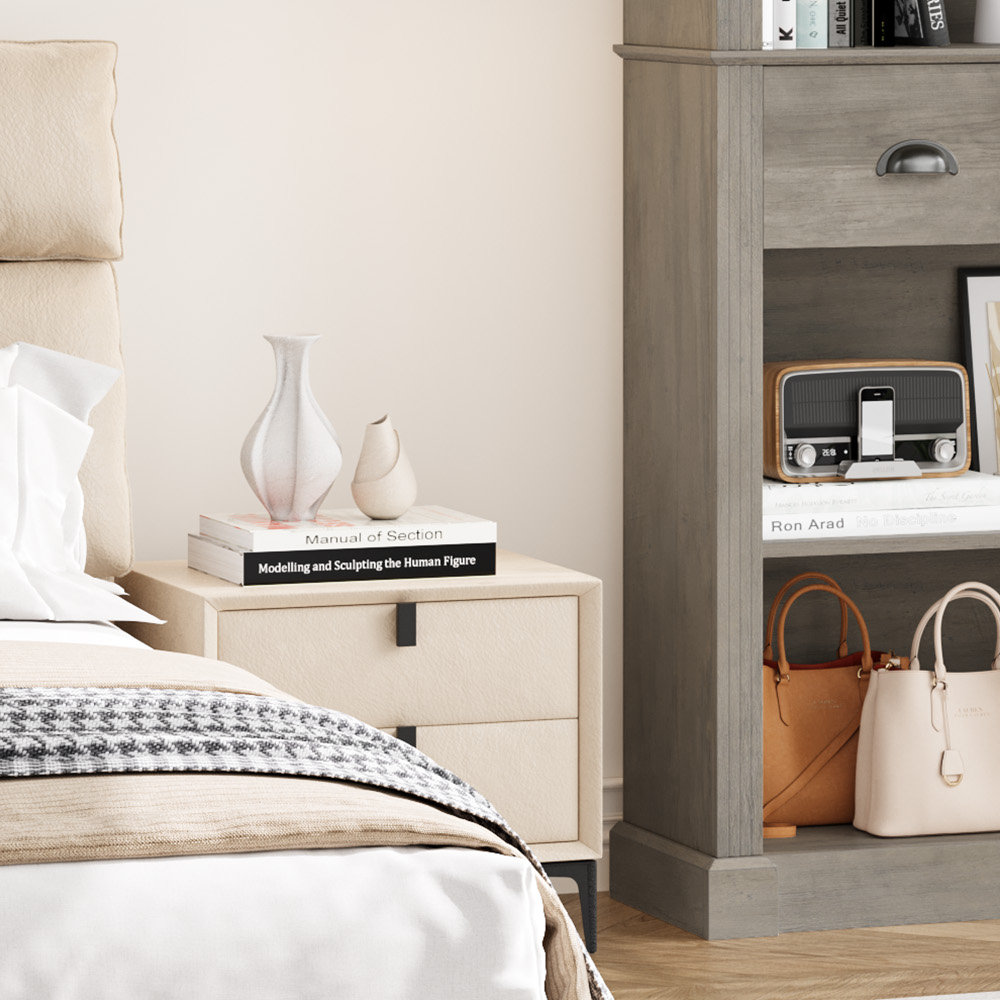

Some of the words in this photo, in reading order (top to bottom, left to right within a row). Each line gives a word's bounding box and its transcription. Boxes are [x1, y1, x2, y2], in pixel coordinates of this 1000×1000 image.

[835, 1, 848, 22] Quiet
[835, 24, 847, 35] All
[771, 519, 803, 533] Ron
[808, 517, 845, 531] Arad
[305, 532, 362, 545] Manual
[367, 530, 382, 543] of
[387, 528, 443, 542] Section
[258, 561, 311, 575] Modelling
[312, 560, 332, 572] and
[334, 559, 383, 572] Sculpting
[384, 557, 402, 569] the
[403, 557, 442, 568] Human
[443, 555, 477, 569] Figure
